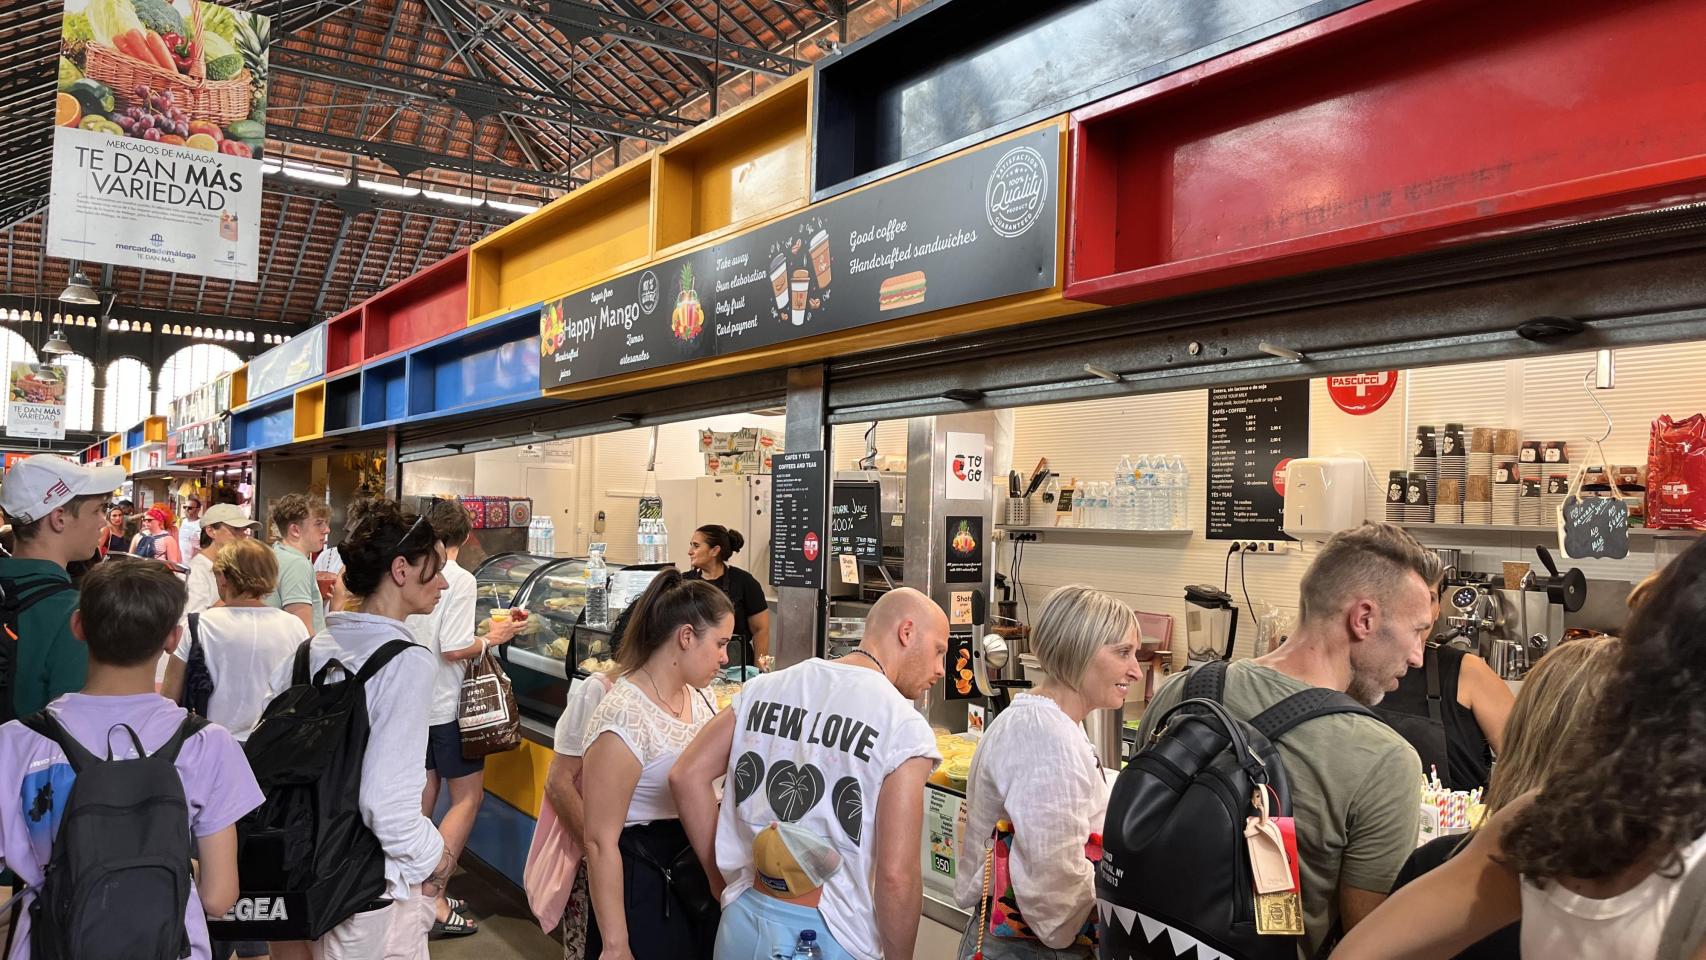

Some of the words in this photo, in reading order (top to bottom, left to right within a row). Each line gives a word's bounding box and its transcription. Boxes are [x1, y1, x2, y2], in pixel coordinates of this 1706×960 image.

[106, 139, 160, 155] MERCADOS
[162, 148, 174, 158] DE
[176, 150, 216, 164] MÁLAGA
[74, 146, 105, 171] TE
[114, 152, 176, 182] DAN
[184, 162, 243, 193] MÁS
[996, 154, 1038, 178] SATISFACTION
[1008, 176, 1024, 186] 100%
[91, 171, 226, 211] VARIEDAD
[991, 170, 1042, 212] Quality
[1006, 202, 1028, 214] PRODUCT
[995, 213, 1032, 230] GUARANTEED
[850, 225, 875, 253] Good
[876, 218, 908, 242] coffee
[146, 254, 160, 262] DAN
[850, 245, 912, 275] Handcrafted
[913, 229, 978, 257] sandwiches
[716, 256, 731, 271] Take
[732, 252, 750, 266] away
[716, 280, 730, 292] Own
[730, 270, 768, 289] elaboration
[590, 290, 604, 304] Sugar
[603, 288, 614, 302] free
[716, 298, 730, 316] Only
[730, 295, 746, 316] fruit
[564, 314, 597, 344] Happy
[600, 302, 640, 330] Mango
[716, 322, 731, 336] Card
[730, 314, 758, 338] payment
[626, 334, 644, 346] Zumos
[620, 350, 650, 366] artesanales
[1332, 376, 1380, 386] PASCUCCI
[968, 455, 982, 468] TO
[968, 469, 982, 482] GO
[832, 504, 850, 515] ATURAL
[832, 517, 854, 531] 100%
[1590, 526, 1599, 537] NO
[746, 700, 808, 741] NEW
[807, 712, 880, 763] LOVE
[1116, 868, 1124, 879] NY
[208, 897, 289, 921] EGEA
